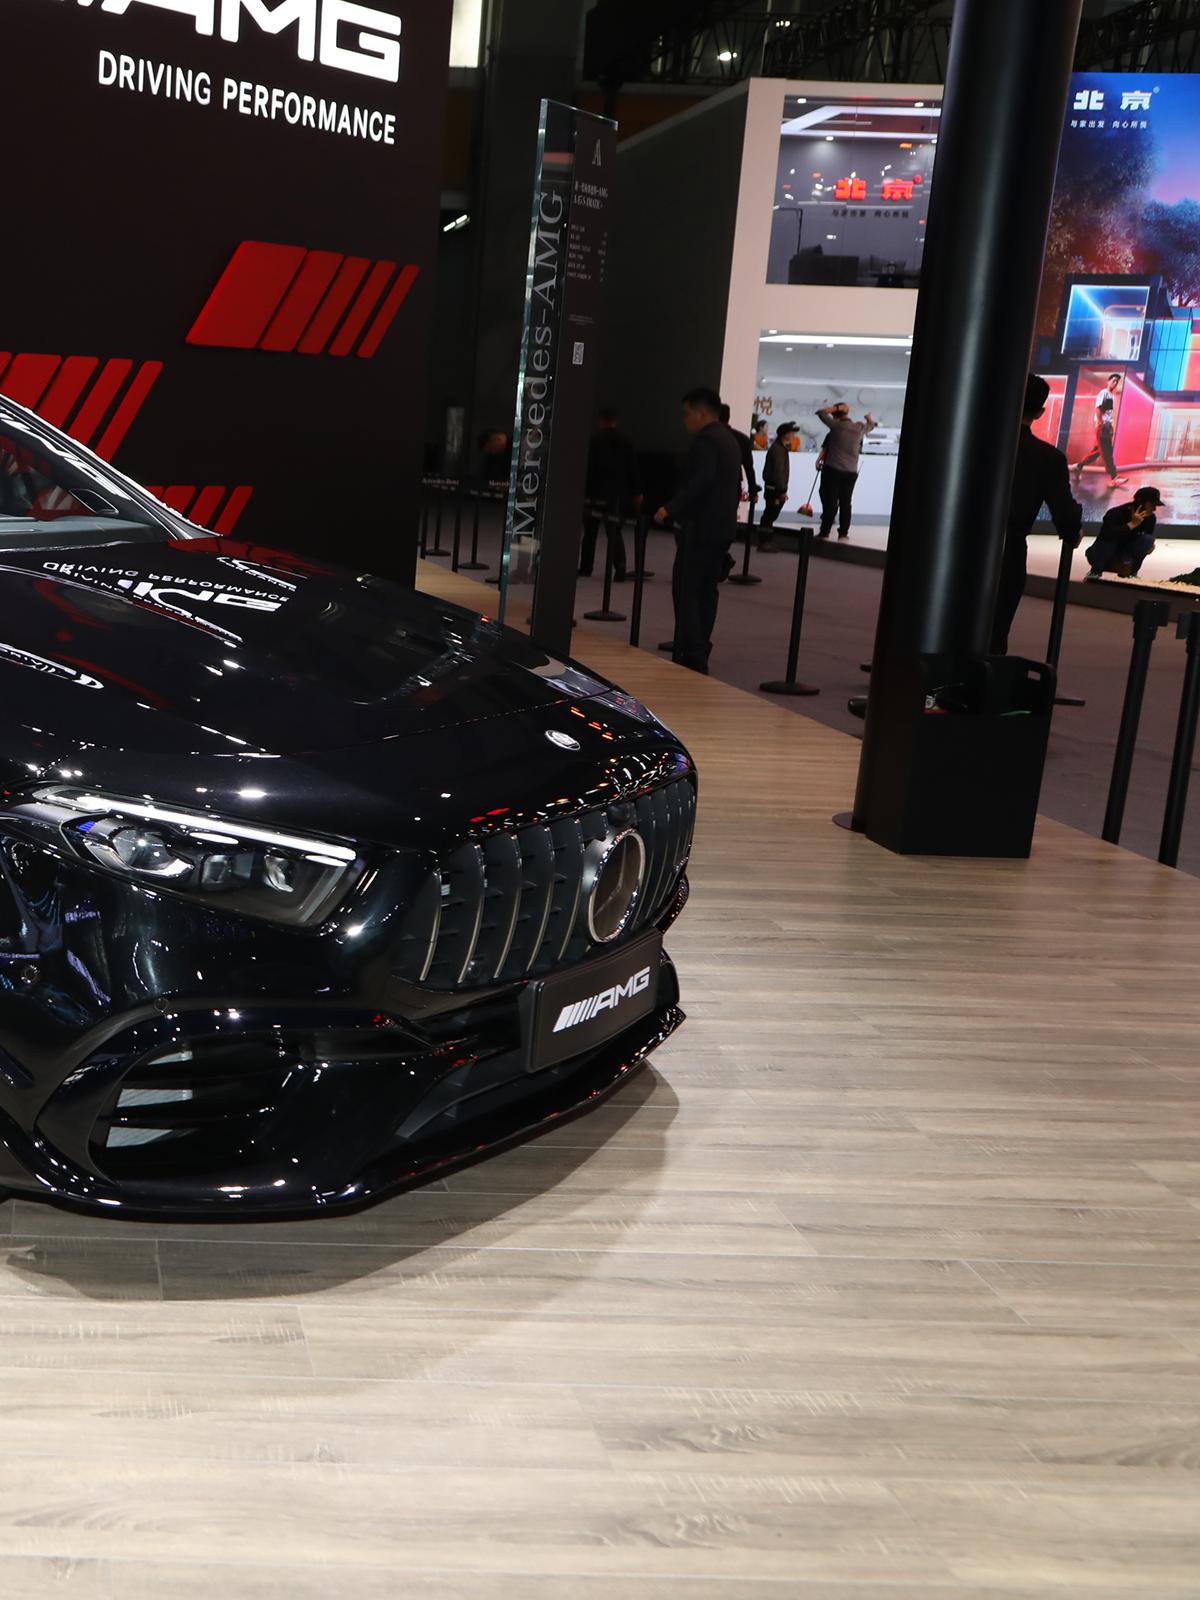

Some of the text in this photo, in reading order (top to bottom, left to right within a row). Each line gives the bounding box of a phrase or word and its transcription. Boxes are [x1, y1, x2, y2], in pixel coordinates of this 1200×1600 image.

[99, 50, 397, 144] DRIVING PERFORMANCE
[1073, 89, 1152, 111] 北京
[834, 177, 914, 201] 北京
[512, 191, 563, 537] Mercedes-AMG
[590, 966, 650, 1018] AMG
